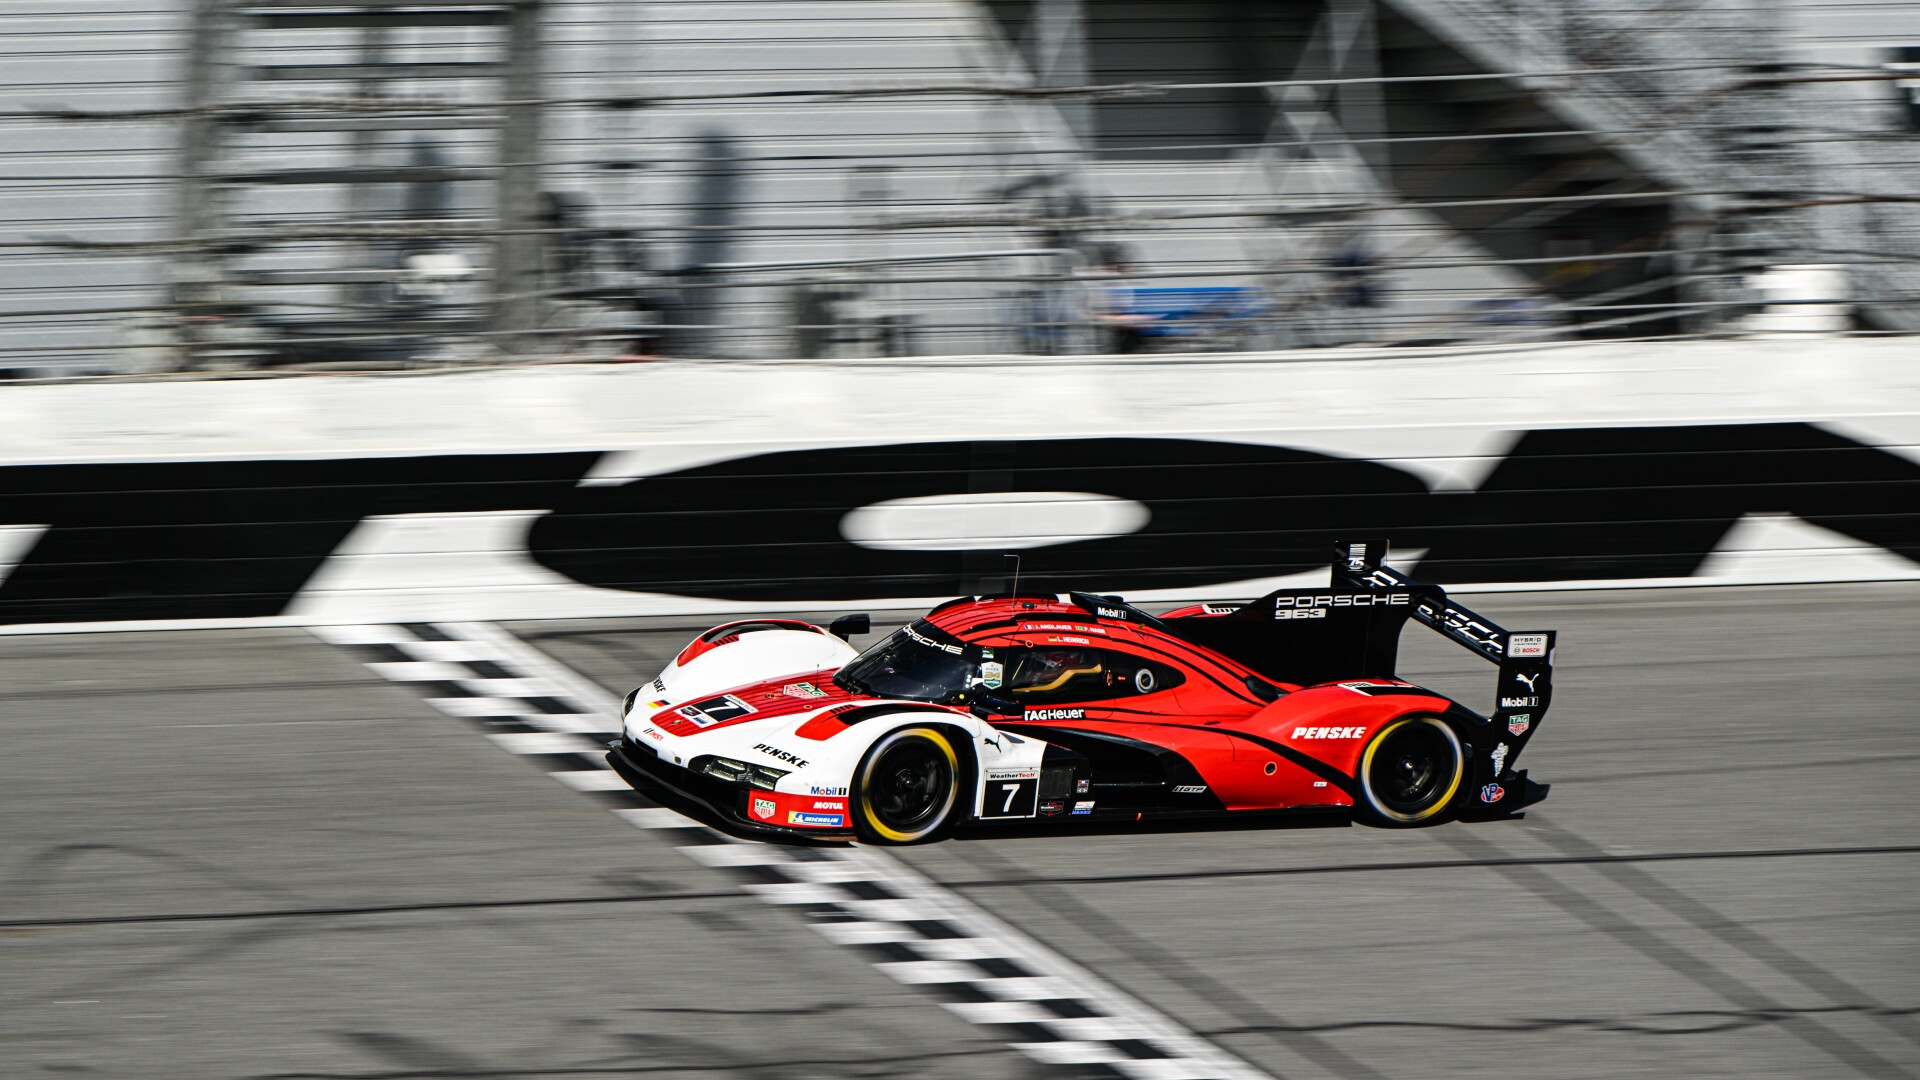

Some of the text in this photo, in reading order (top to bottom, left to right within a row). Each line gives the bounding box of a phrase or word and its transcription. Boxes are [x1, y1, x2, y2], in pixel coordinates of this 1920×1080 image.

[1275, 594, 1410, 609] PORSCHE
[1097, 606, 1119, 618] Mobil
[1275, 608, 1327, 620] 963
[703, 701, 740, 713] 7
[1502, 697, 1528, 707] Mobil
[1291, 727, 1367, 739] PENSKE
[752, 743, 810, 769] PENSKE
[811, 786, 837, 796] Mobil
[1002, 783, 1021, 813] 7
[756, 800, 775, 810] TAG
[813, 801, 844, 810] MOTUL
